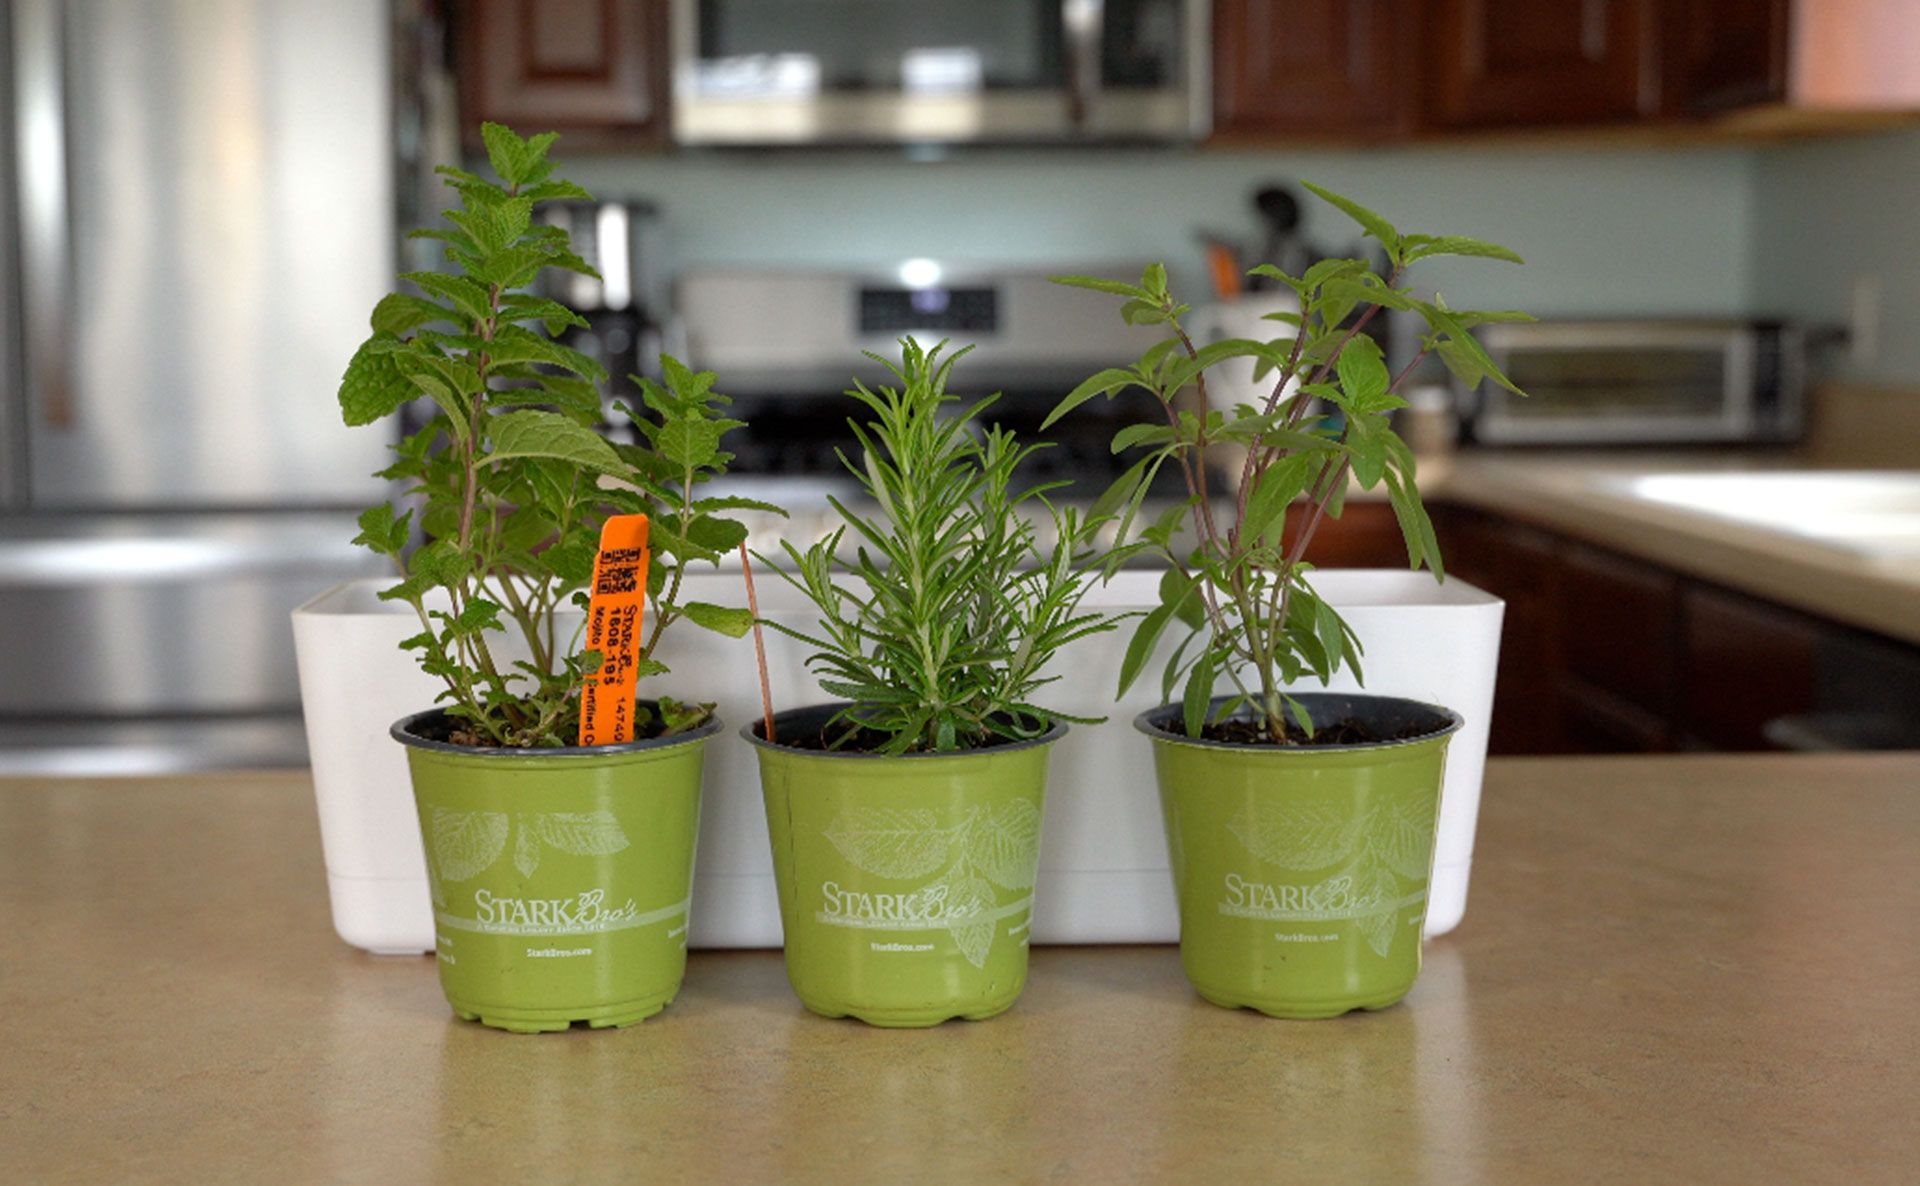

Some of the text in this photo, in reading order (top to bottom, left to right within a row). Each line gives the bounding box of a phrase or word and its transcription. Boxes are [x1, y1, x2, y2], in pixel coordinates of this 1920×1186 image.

[475, 889, 575, 925] STARK
[822, 881, 917, 920] STARK
[1225, 873, 1322, 912] STARK
